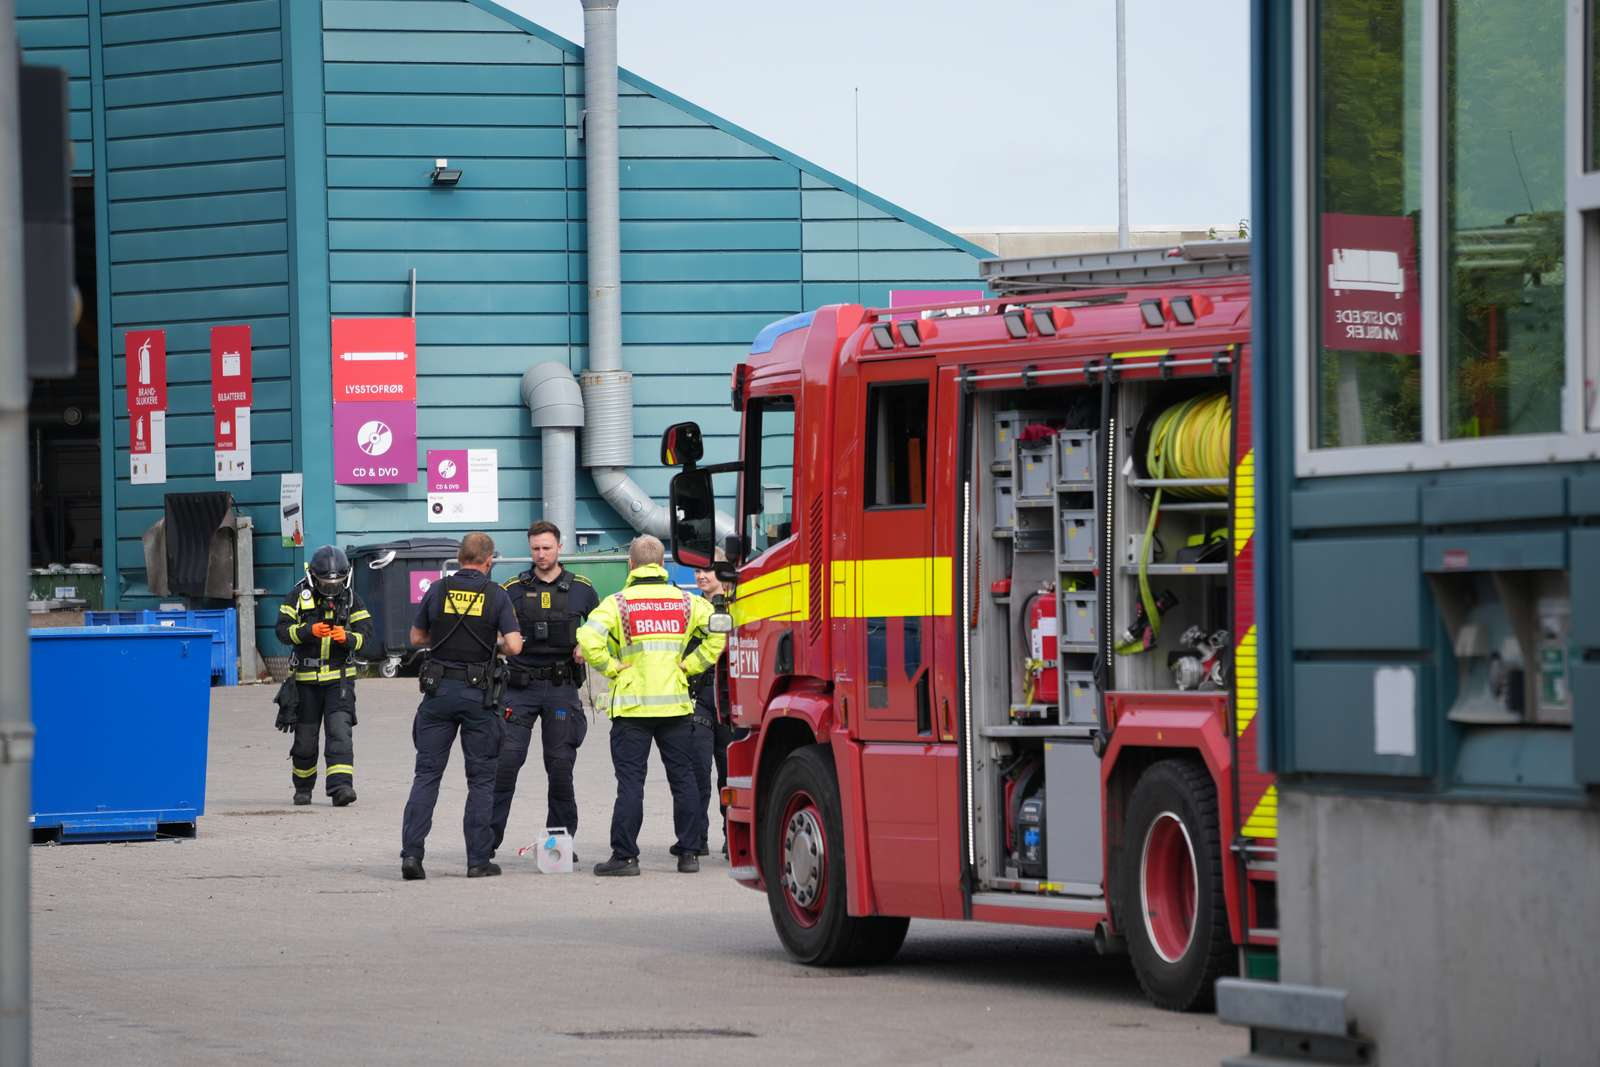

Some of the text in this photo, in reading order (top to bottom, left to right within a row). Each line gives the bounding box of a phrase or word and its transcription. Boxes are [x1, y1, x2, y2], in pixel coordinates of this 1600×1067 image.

[345, 384, 404, 394] LYSSTOFRØR
[352, 467, 399, 477] CD & DVD
[635, 619, 680, 633] BRAND
[739, 650, 760, 674] FYN
